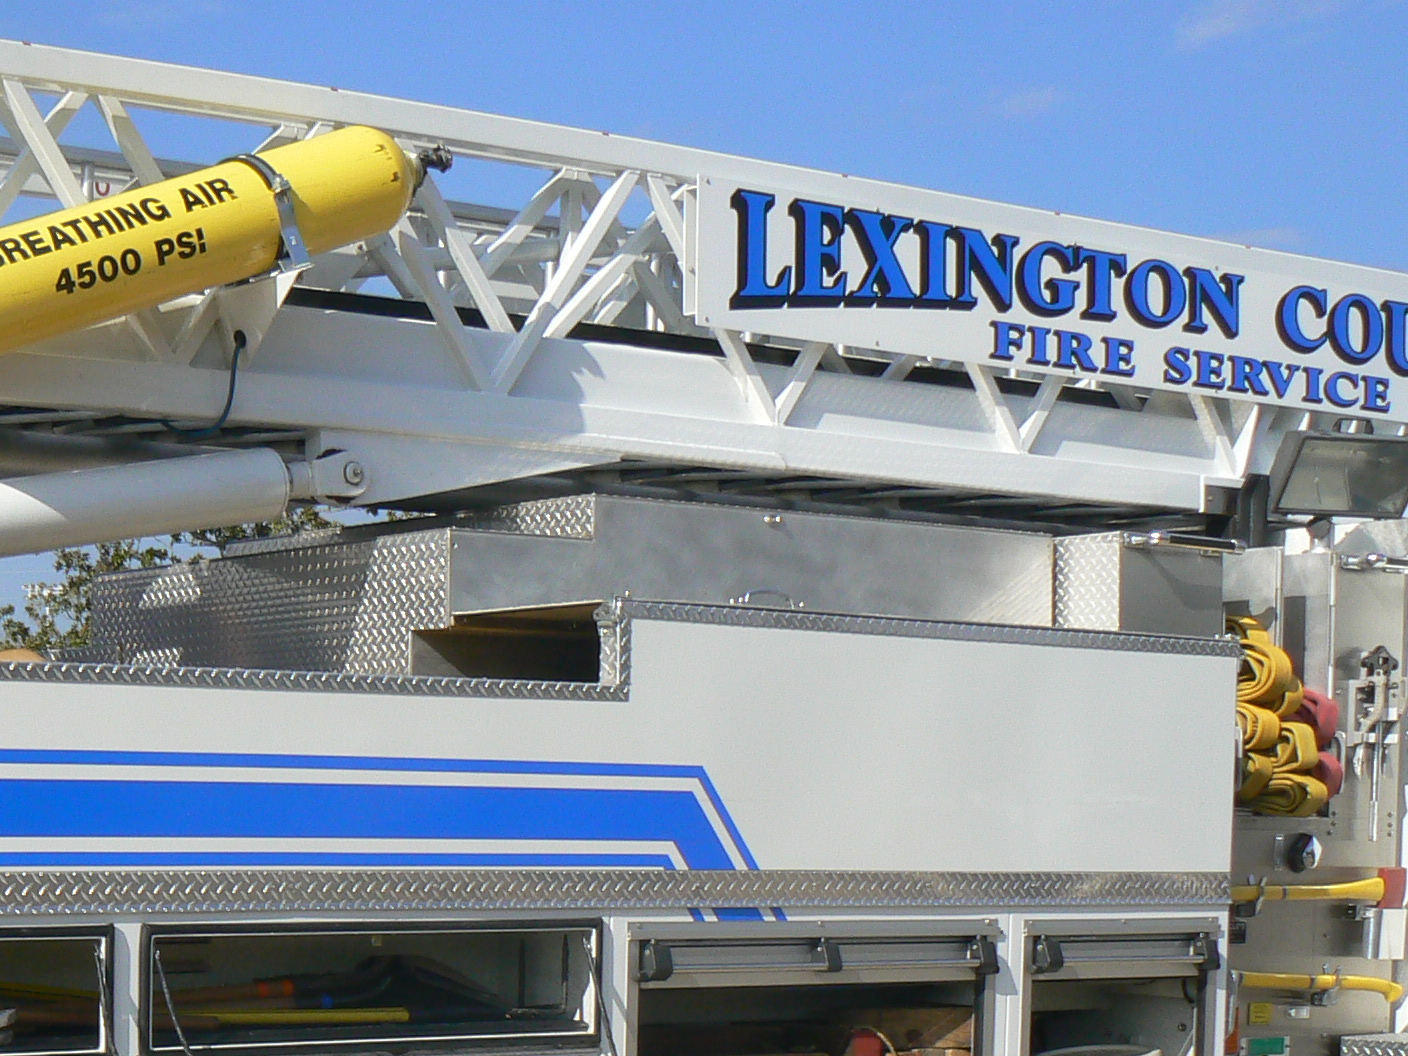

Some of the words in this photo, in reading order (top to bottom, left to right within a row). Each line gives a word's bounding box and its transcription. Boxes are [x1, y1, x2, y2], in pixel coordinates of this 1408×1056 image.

[178, 178, 238, 213] AIR
[55, 249, 142, 295] 4500
[154, 228, 208, 267] PSI
[729, 187, 1245, 340] LEXINGTON
[989, 320, 1136, 377] FIRE
[1163, 346, 1391, 412] SERVICE
